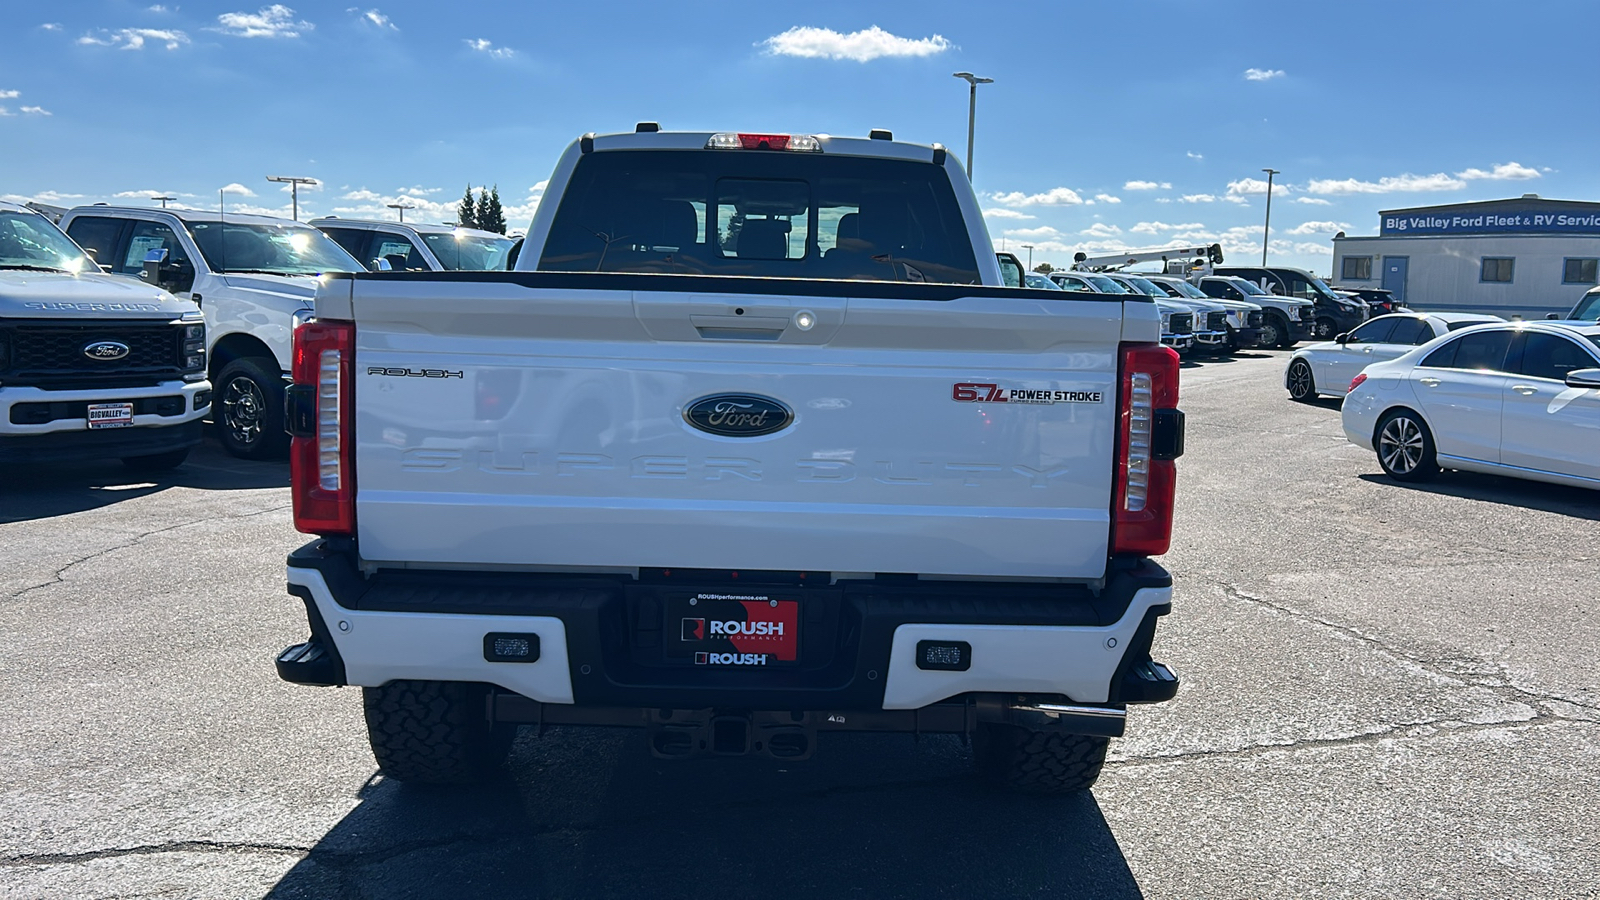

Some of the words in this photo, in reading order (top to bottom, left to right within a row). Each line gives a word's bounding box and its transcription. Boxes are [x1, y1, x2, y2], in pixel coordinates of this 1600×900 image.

[1386, 218, 1407, 230] Big
[1410, 217, 1450, 229] Valley
[1452, 215, 1483, 227] Ford
[1486, 215, 1521, 226] Fleet
[1523, 217, 1531, 226] &
[1534, 214, 1555, 226] RV
[24, 302, 106, 311] SUPER
[95, 345, 120, 356] Ford
[367, 366, 463, 379] ROUSH
[1010, 389, 1052, 400] POWER
[1054, 391, 1101, 402] STROKE
[707, 401, 769, 427] Ford
[401, 448, 763, 481] SUPER
[796, 458, 1069, 488] DUTY
[697, 593, 769, 601] ROUSHperformance.com
[710, 620, 784, 636] ROUSH
[709, 652, 766, 666] ROUSH
